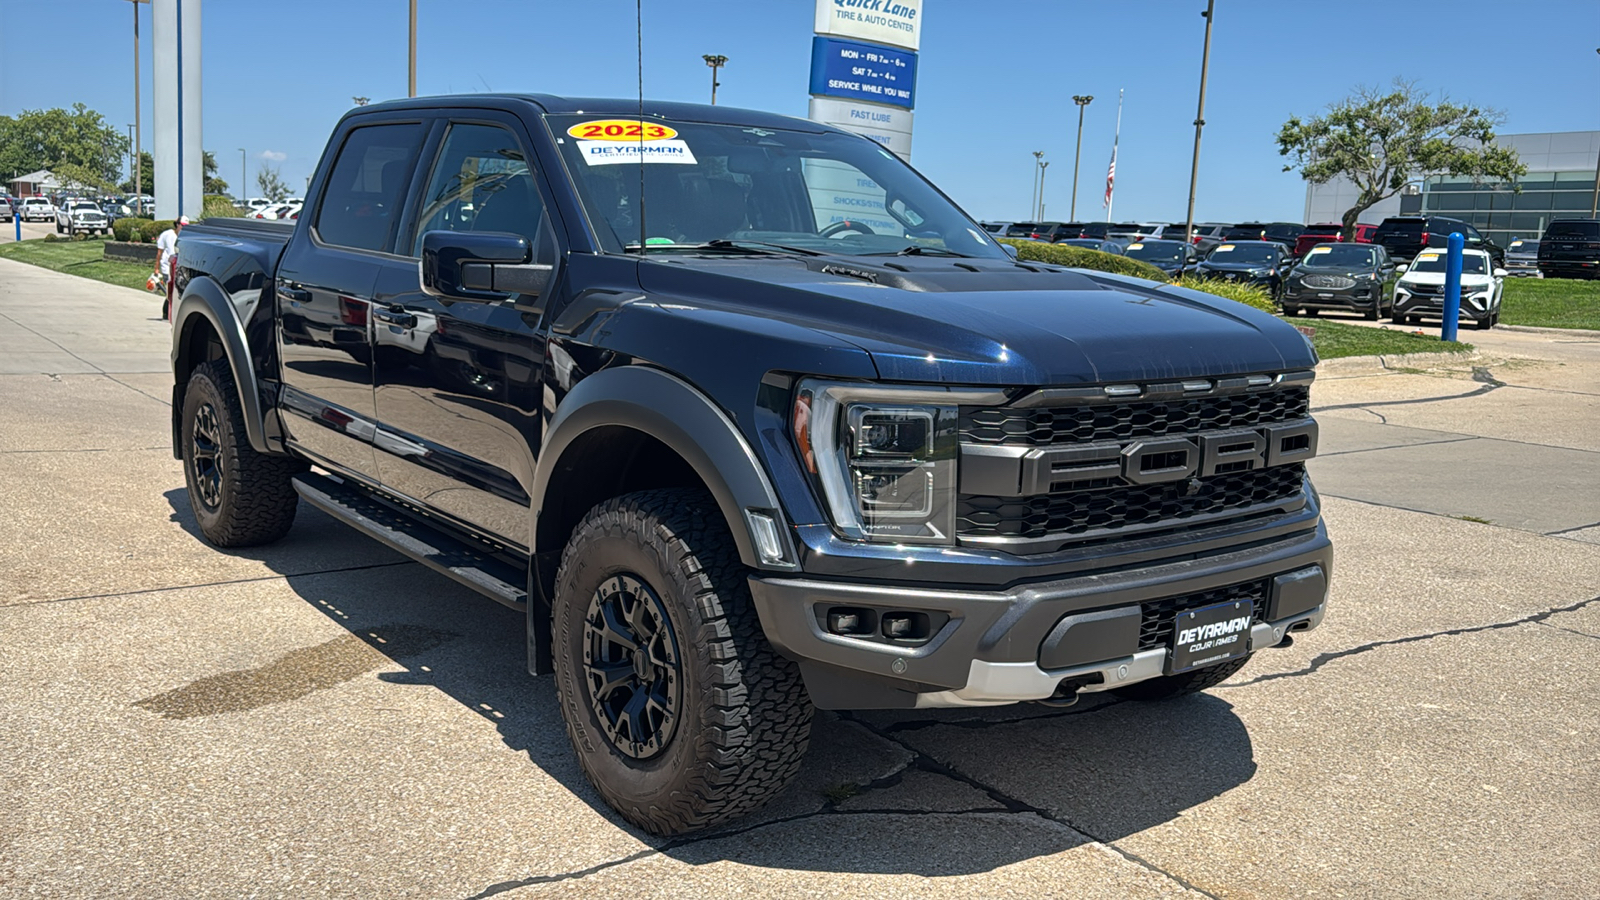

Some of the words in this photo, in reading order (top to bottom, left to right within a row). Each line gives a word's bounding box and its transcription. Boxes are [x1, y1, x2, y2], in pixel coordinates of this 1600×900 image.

[883, 0, 916, 19] Lane
[836, 10, 855, 20] TIRE
[857, 13, 863, 22] &
[865, 14, 886, 26] AUTO
[887, 19, 914, 33] CENTER
[841, 49, 859, 59] MON
[866, 53, 877, 62] FRI
[852, 66, 866, 76] SAT
[828, 79, 860, 91] SERVICE
[862, 83, 882, 94] WHILE
[884, 87, 897, 97] YOU
[898, 90, 911, 99] WAIT
[851, 109, 870, 120] FAST
[872, 113, 891, 123] LUBE
[583, 125, 666, 137] 2023
[591, 146, 683, 154] DEYARMAN
[857, 178, 878, 188] TIRES
[1021, 417, 1318, 495] FORD
[1177, 615, 1251, 645] DEYARMAN
[1215, 634, 1239, 647] AMES
